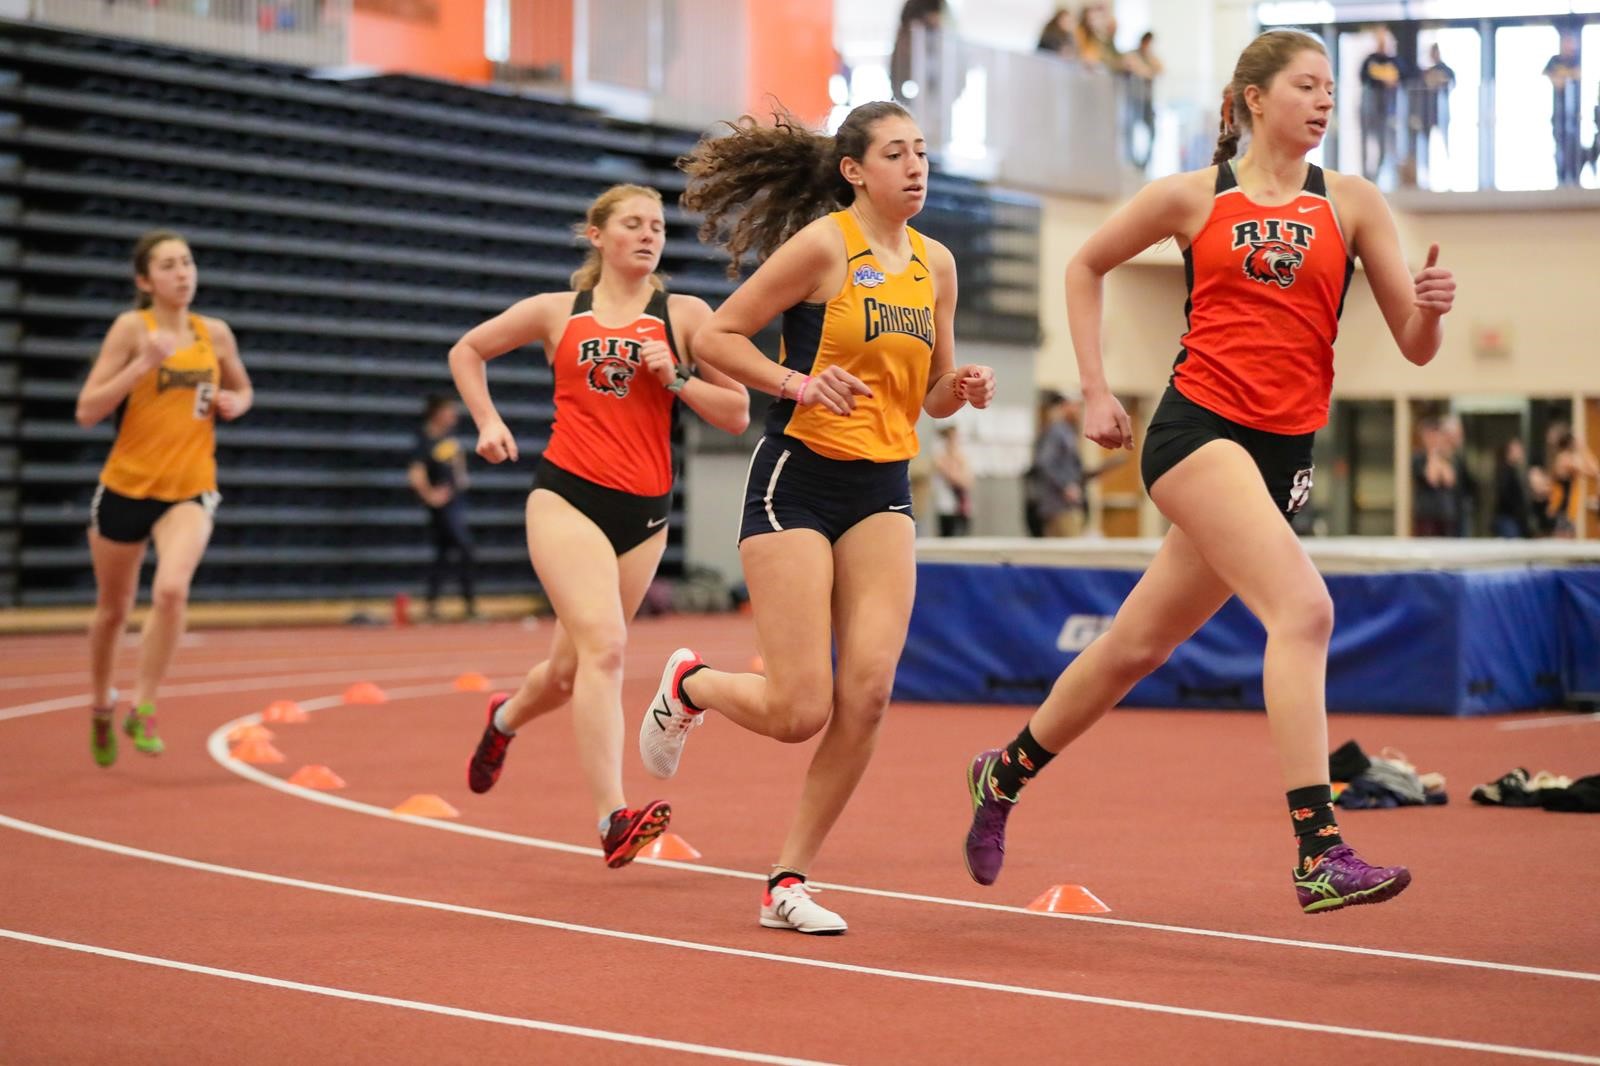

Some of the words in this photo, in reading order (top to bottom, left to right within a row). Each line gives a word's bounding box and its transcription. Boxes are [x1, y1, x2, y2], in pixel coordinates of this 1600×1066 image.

[1231, 219, 1315, 250] RIT
[864, 297, 933, 342] CANISIUS
[577, 336, 642, 366] RIT
